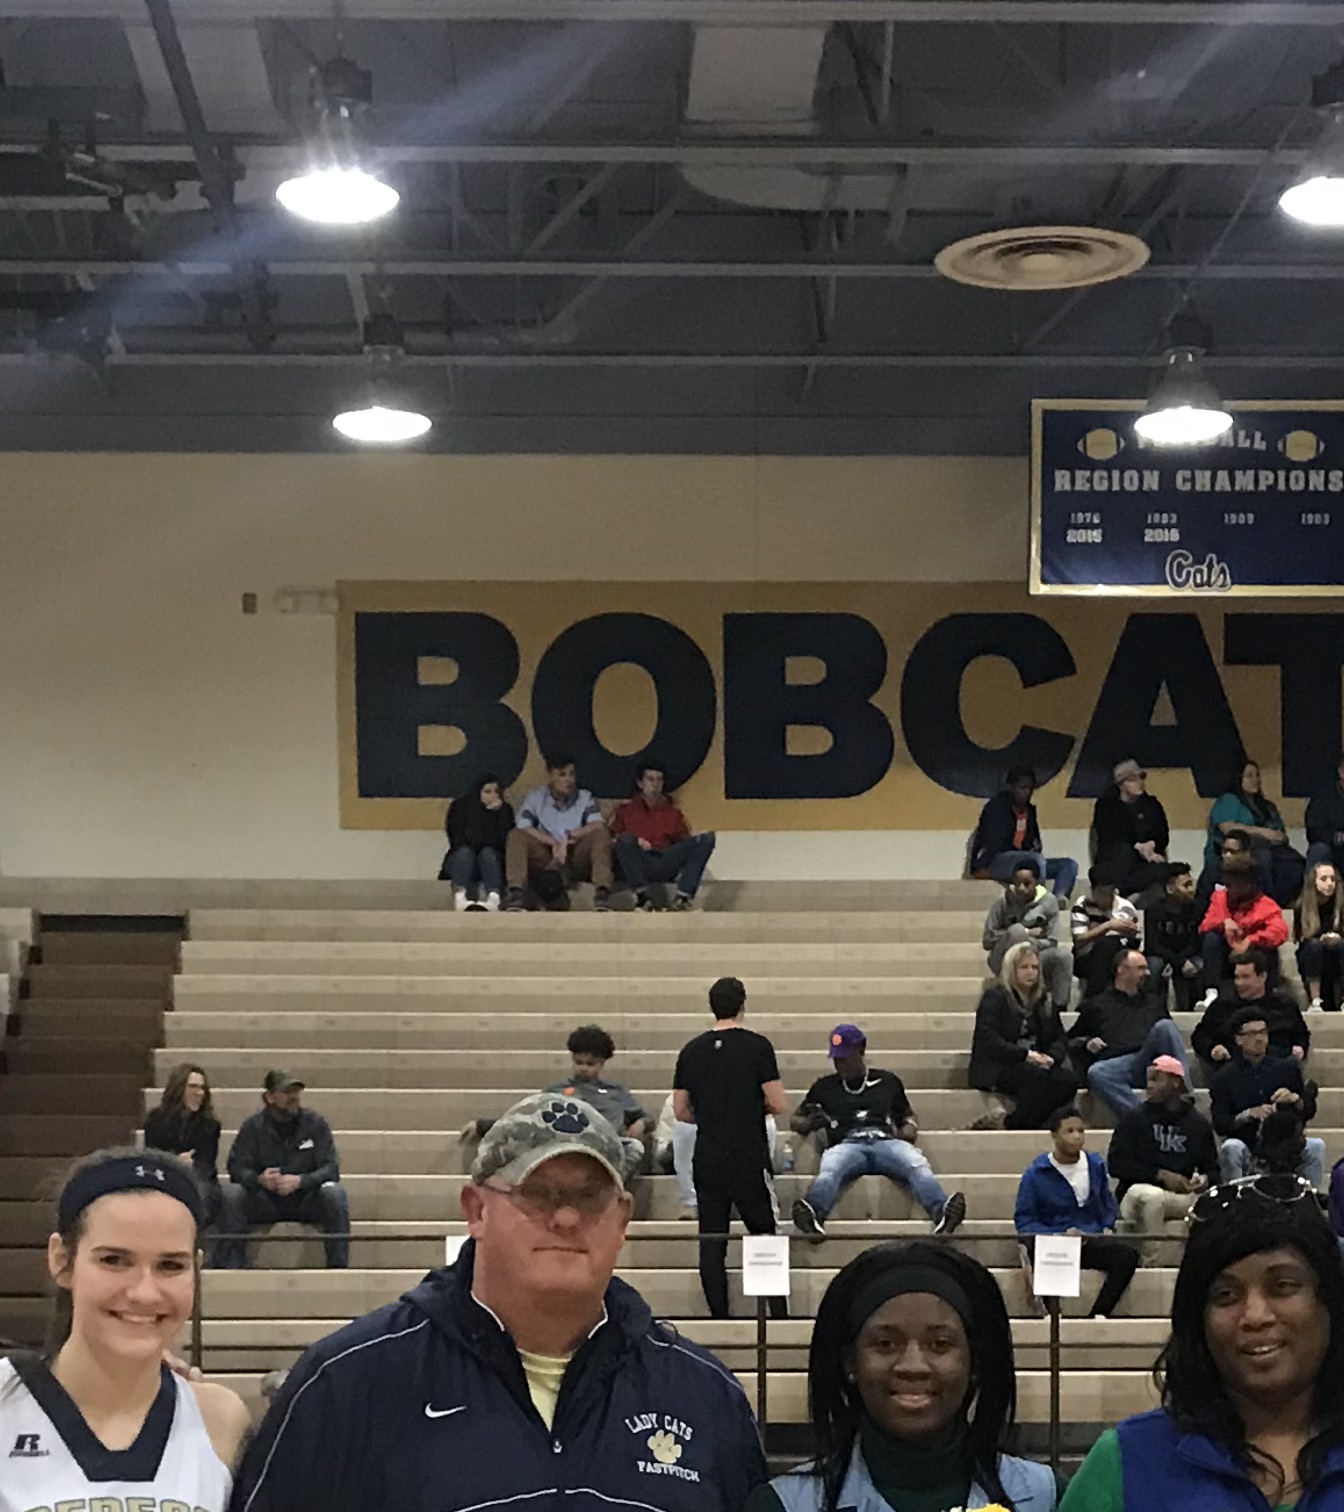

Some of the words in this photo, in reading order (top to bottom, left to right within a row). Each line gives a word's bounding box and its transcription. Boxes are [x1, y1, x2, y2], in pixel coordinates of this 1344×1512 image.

[1054, 469, 1160, 492] REGION
[1175, 469, 1344, 492] CHAMPIONS
[1165, 549, 1232, 591] Cats
[624, 1412, 658, 1435] LADY
[664, 1412, 694, 1441] CATS
[636, 1459, 701, 1483] FASTPITCH
